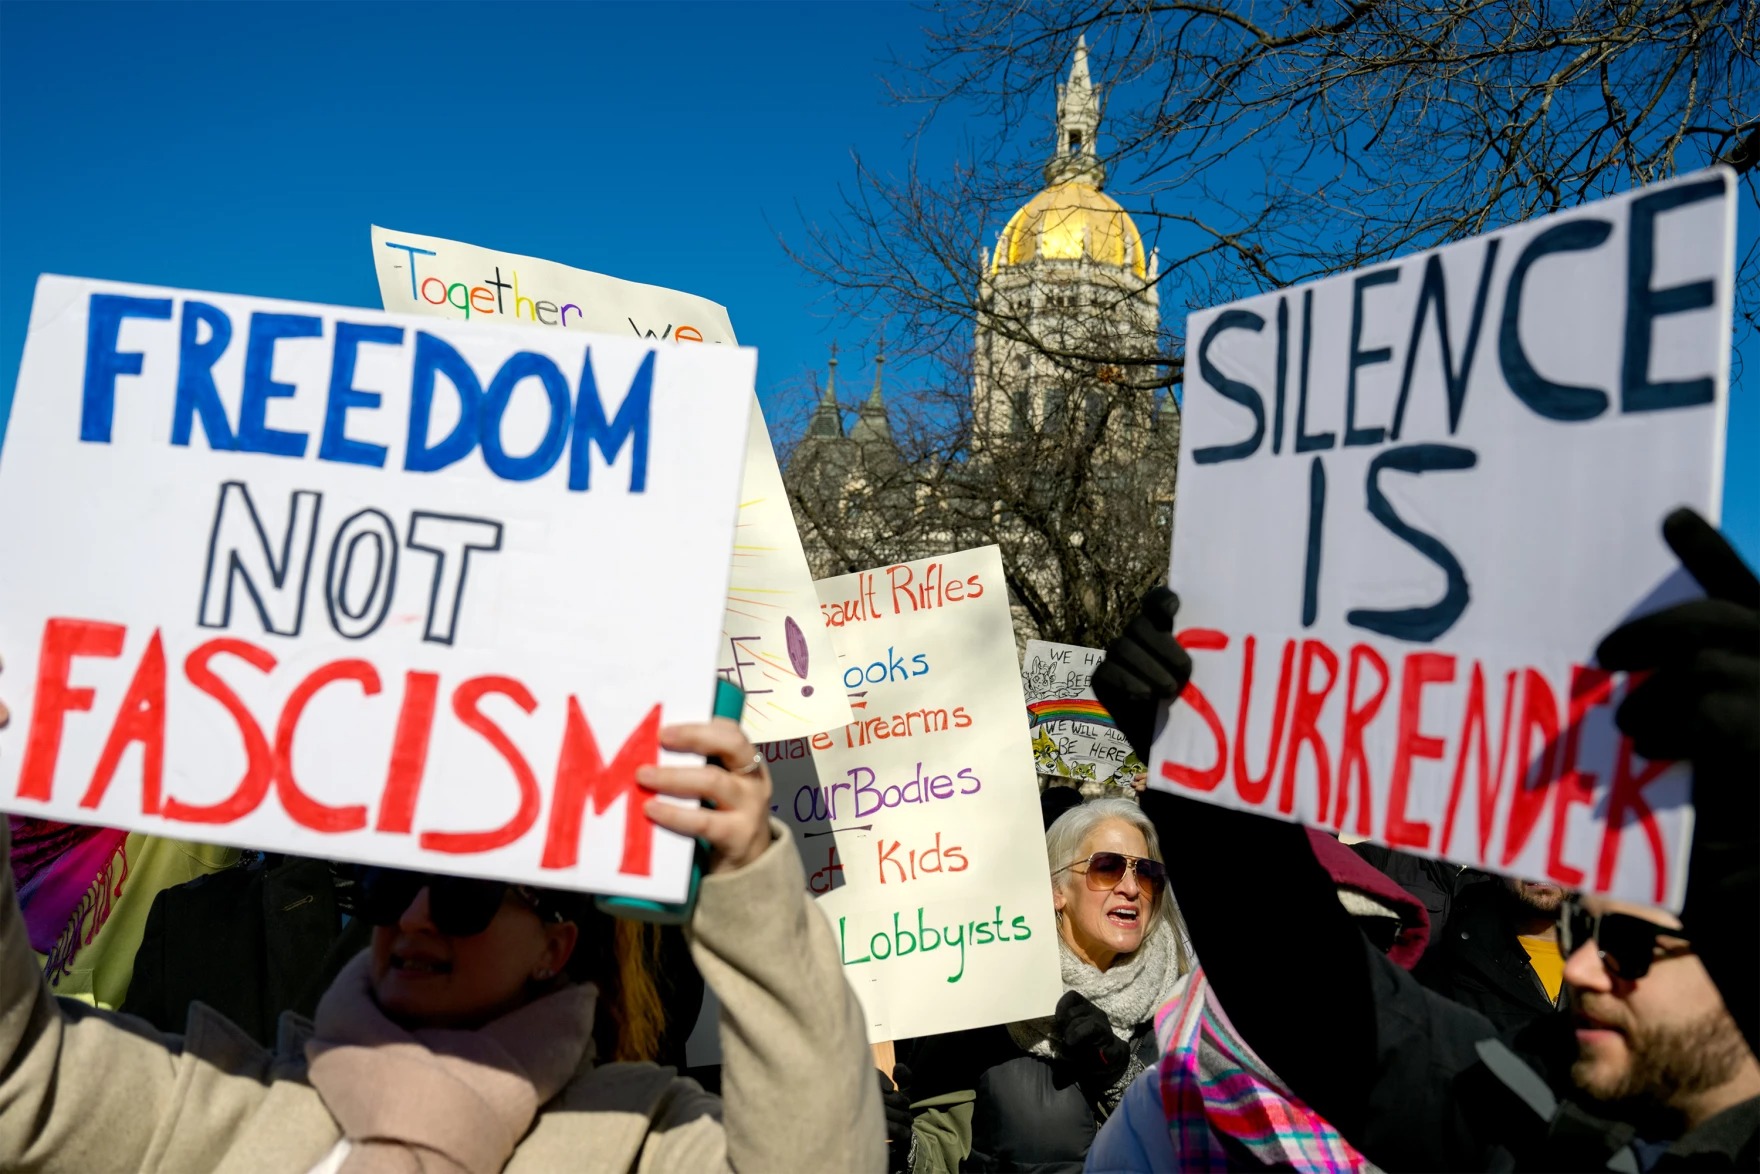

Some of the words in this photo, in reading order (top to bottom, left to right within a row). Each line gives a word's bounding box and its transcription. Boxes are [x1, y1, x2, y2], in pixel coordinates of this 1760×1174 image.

[385, 241, 583, 327] Together
[1192, 179, 1727, 465] SILENCE
[79, 292, 657, 493] FREEDOM
[197, 480, 504, 646] NOT
[1301, 442, 1479, 643] IS
[820, 573, 882, 628] sault
[886, 563, 984, 615] Rifles
[843, 646, 930, 688] ooks
[1050, 648, 1073, 664] WE
[1084, 652, 1104, 666] HA
[1066, 670, 1093, 688] BEE
[16, 617, 664, 879] FASCISM
[1046, 720, 1067, 735] WE
[1071, 722, 1099, 737] WILL
[1058, 736, 1079, 756] BE
[1089, 741, 1127, 763] HERE
[1161, 626, 1680, 906] SURRENDER
[877, 831, 970, 885] Kids
[840, 905, 1032, 983] Lobbyists
